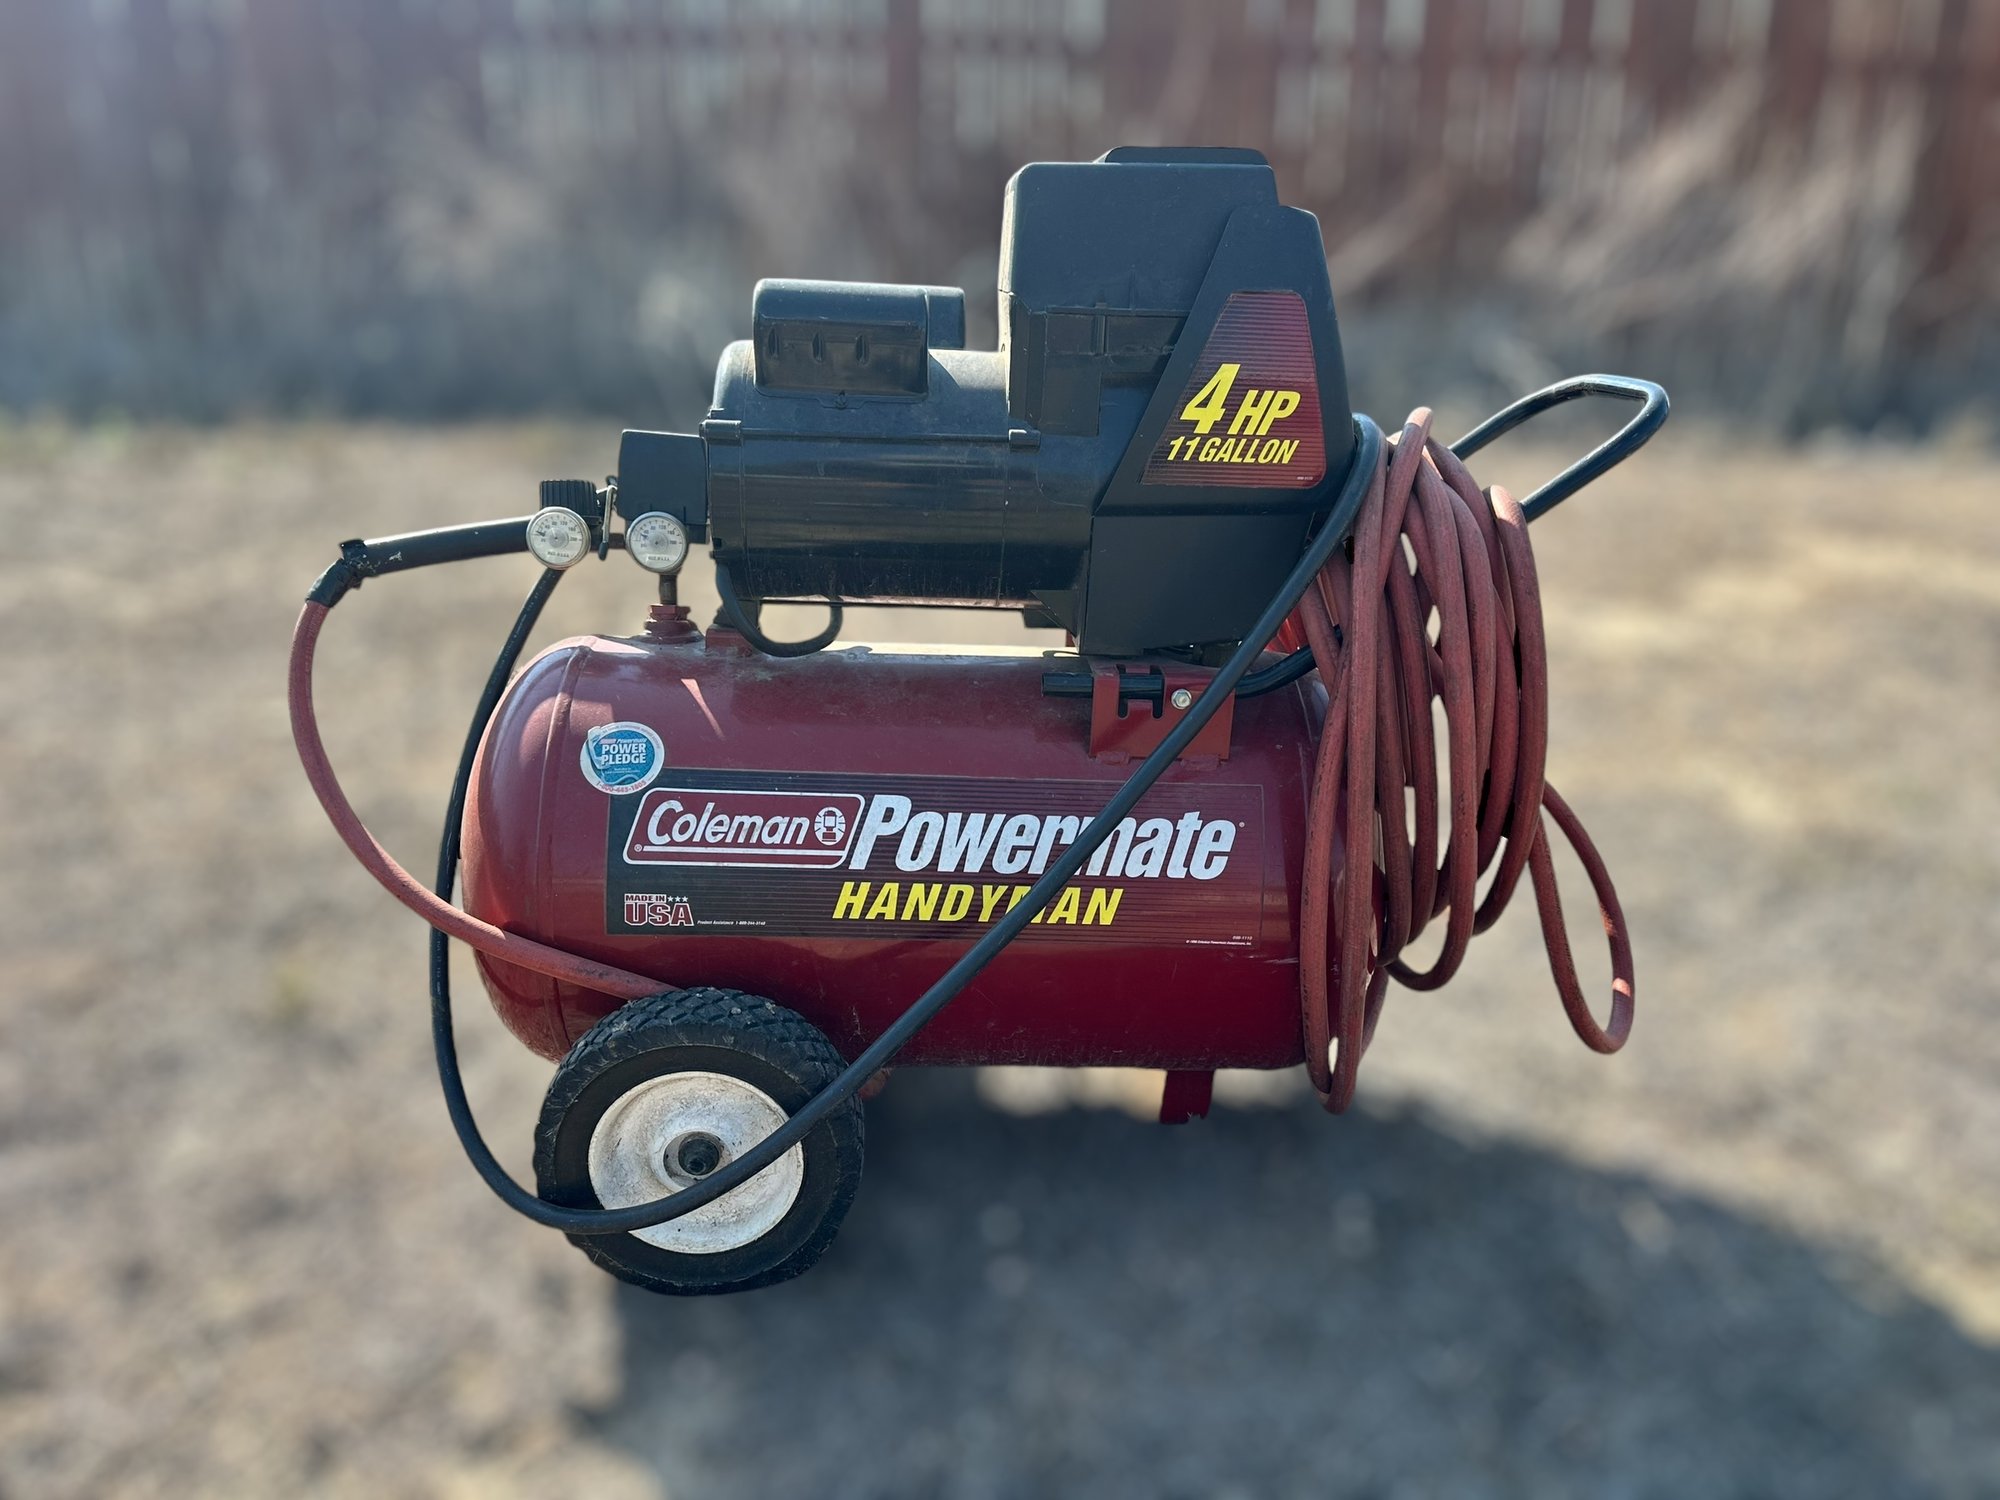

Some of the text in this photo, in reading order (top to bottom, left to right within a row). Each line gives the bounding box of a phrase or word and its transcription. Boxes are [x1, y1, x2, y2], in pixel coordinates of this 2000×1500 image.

[1179, 363, 1301, 437] 4 HP
[1167, 436, 1300, 465] 11 GALLON
[601, 743, 647, 755] POWER
[601, 753, 647, 765] PLEDGE
[647, 799, 811, 846] Coleman
[625, 894, 666, 902] MADE IN
[624, 902, 695, 927] USA
